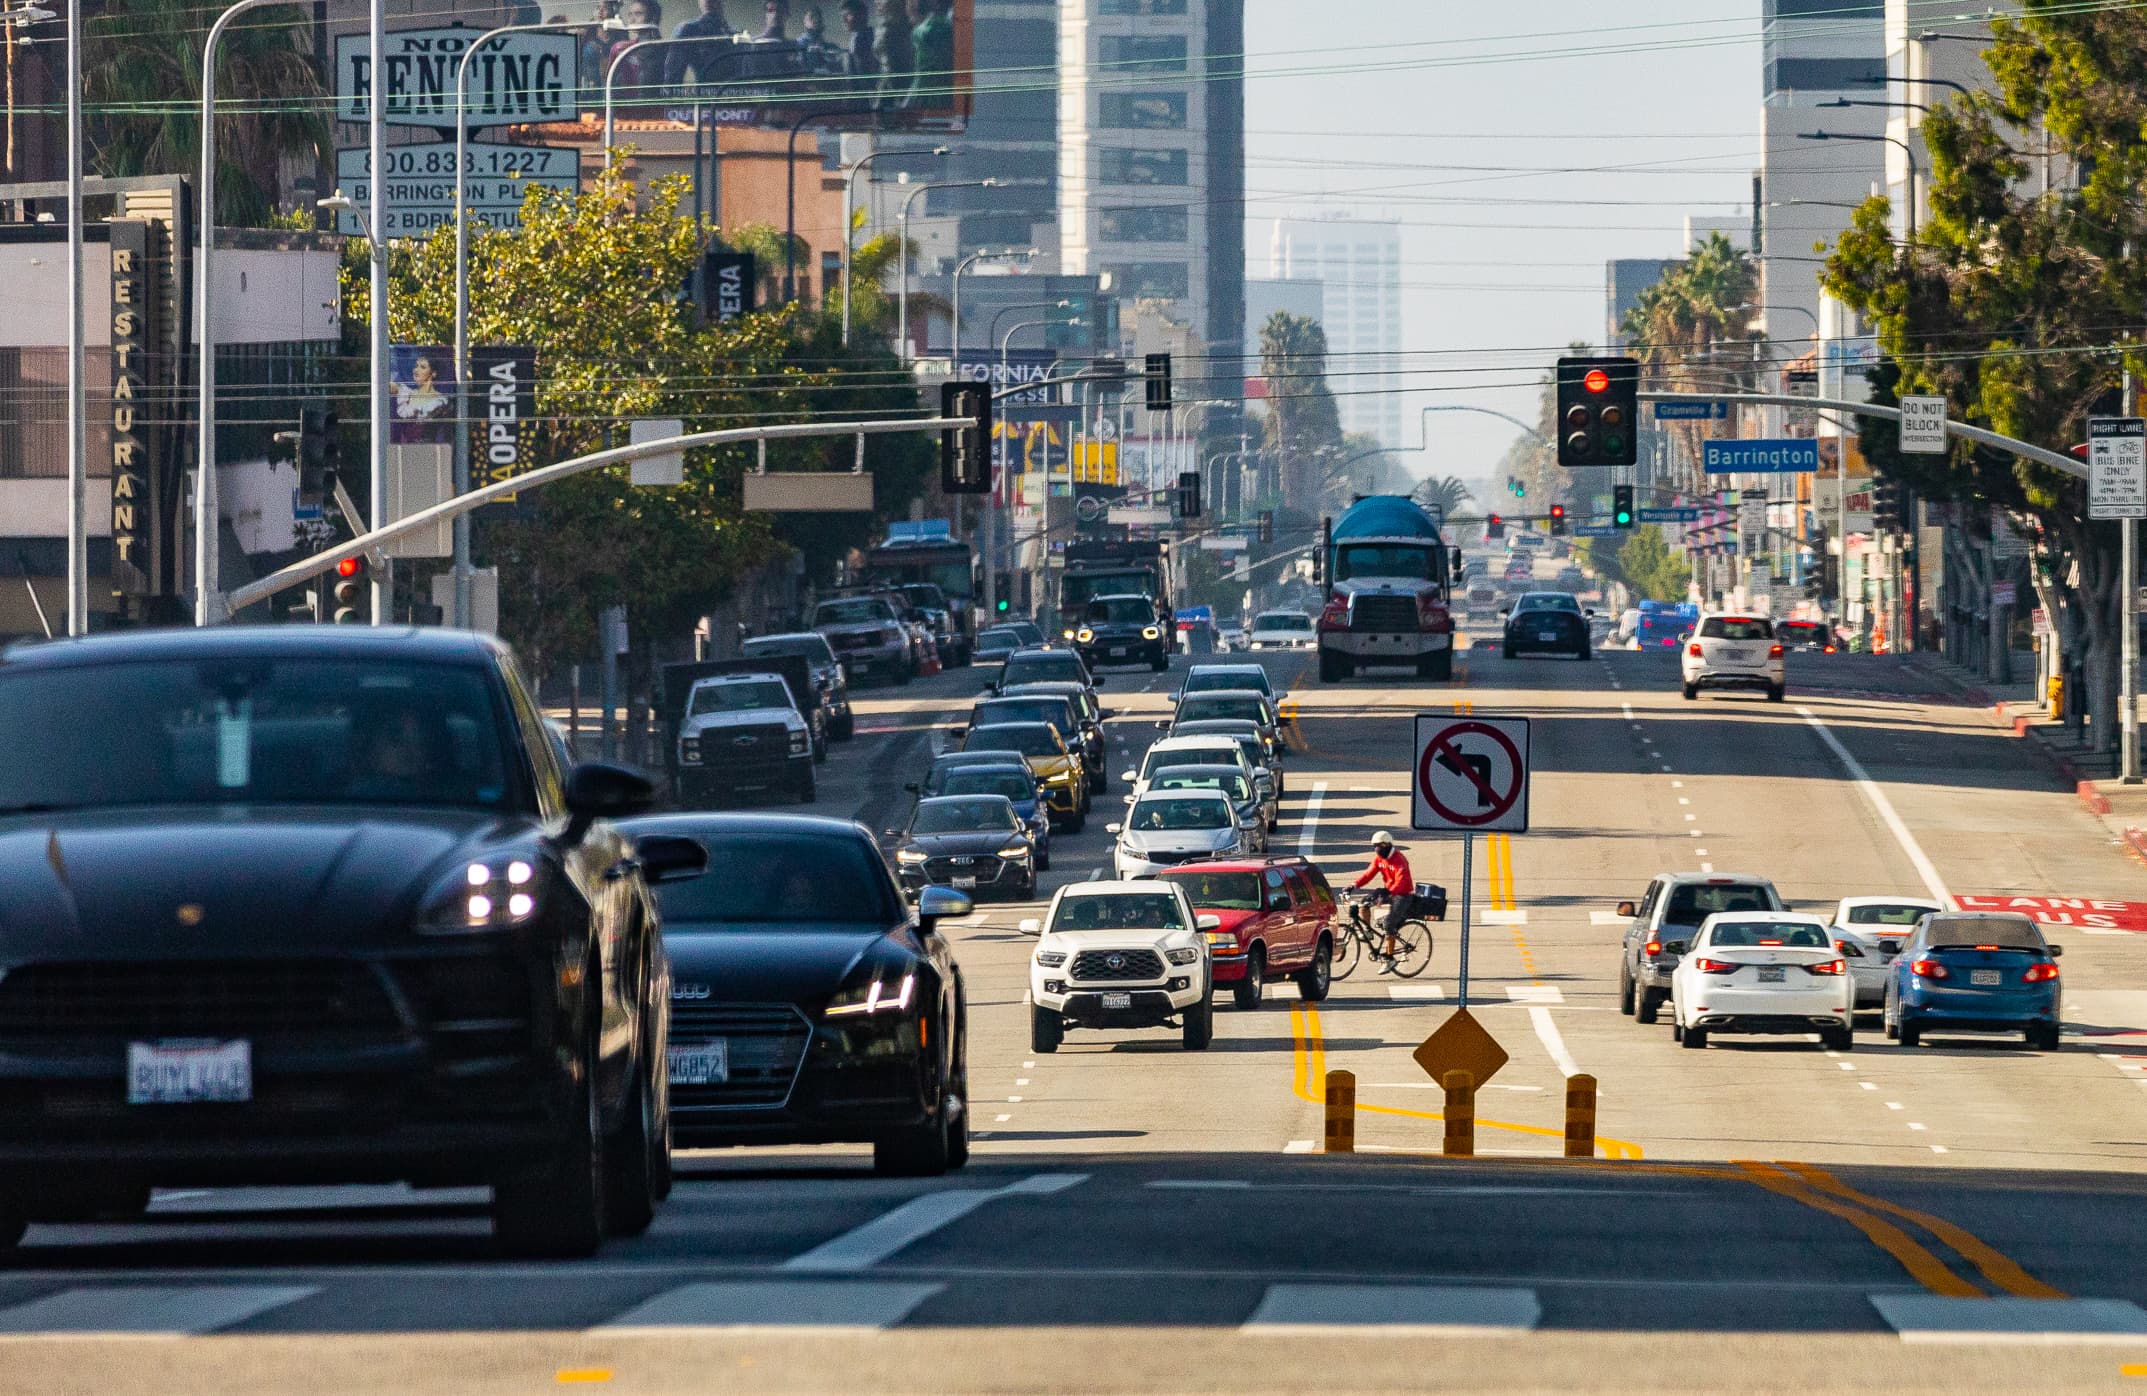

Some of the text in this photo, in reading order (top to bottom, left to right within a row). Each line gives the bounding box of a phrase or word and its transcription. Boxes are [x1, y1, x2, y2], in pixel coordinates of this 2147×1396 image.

[403, 38, 510, 52] NOW
[351, 54, 563, 116] RENTING
[354, 183, 559, 201] BRRINGTN PLA
[113, 249, 134, 562] RESTAURANT
[1903, 402, 1944, 415] DO NOT
[1905, 419, 1940, 431] BLOCK
[2092, 424, 2143, 433] RIGHT LANE
[1708, 448, 1815, 470] Barrington
[2097, 456, 2140, 465] BUS BIKE
[2104, 467, 2131, 476] ONLY
[1961, 896, 2129, 911] LANE
[2036, 911, 2118, 928] US
